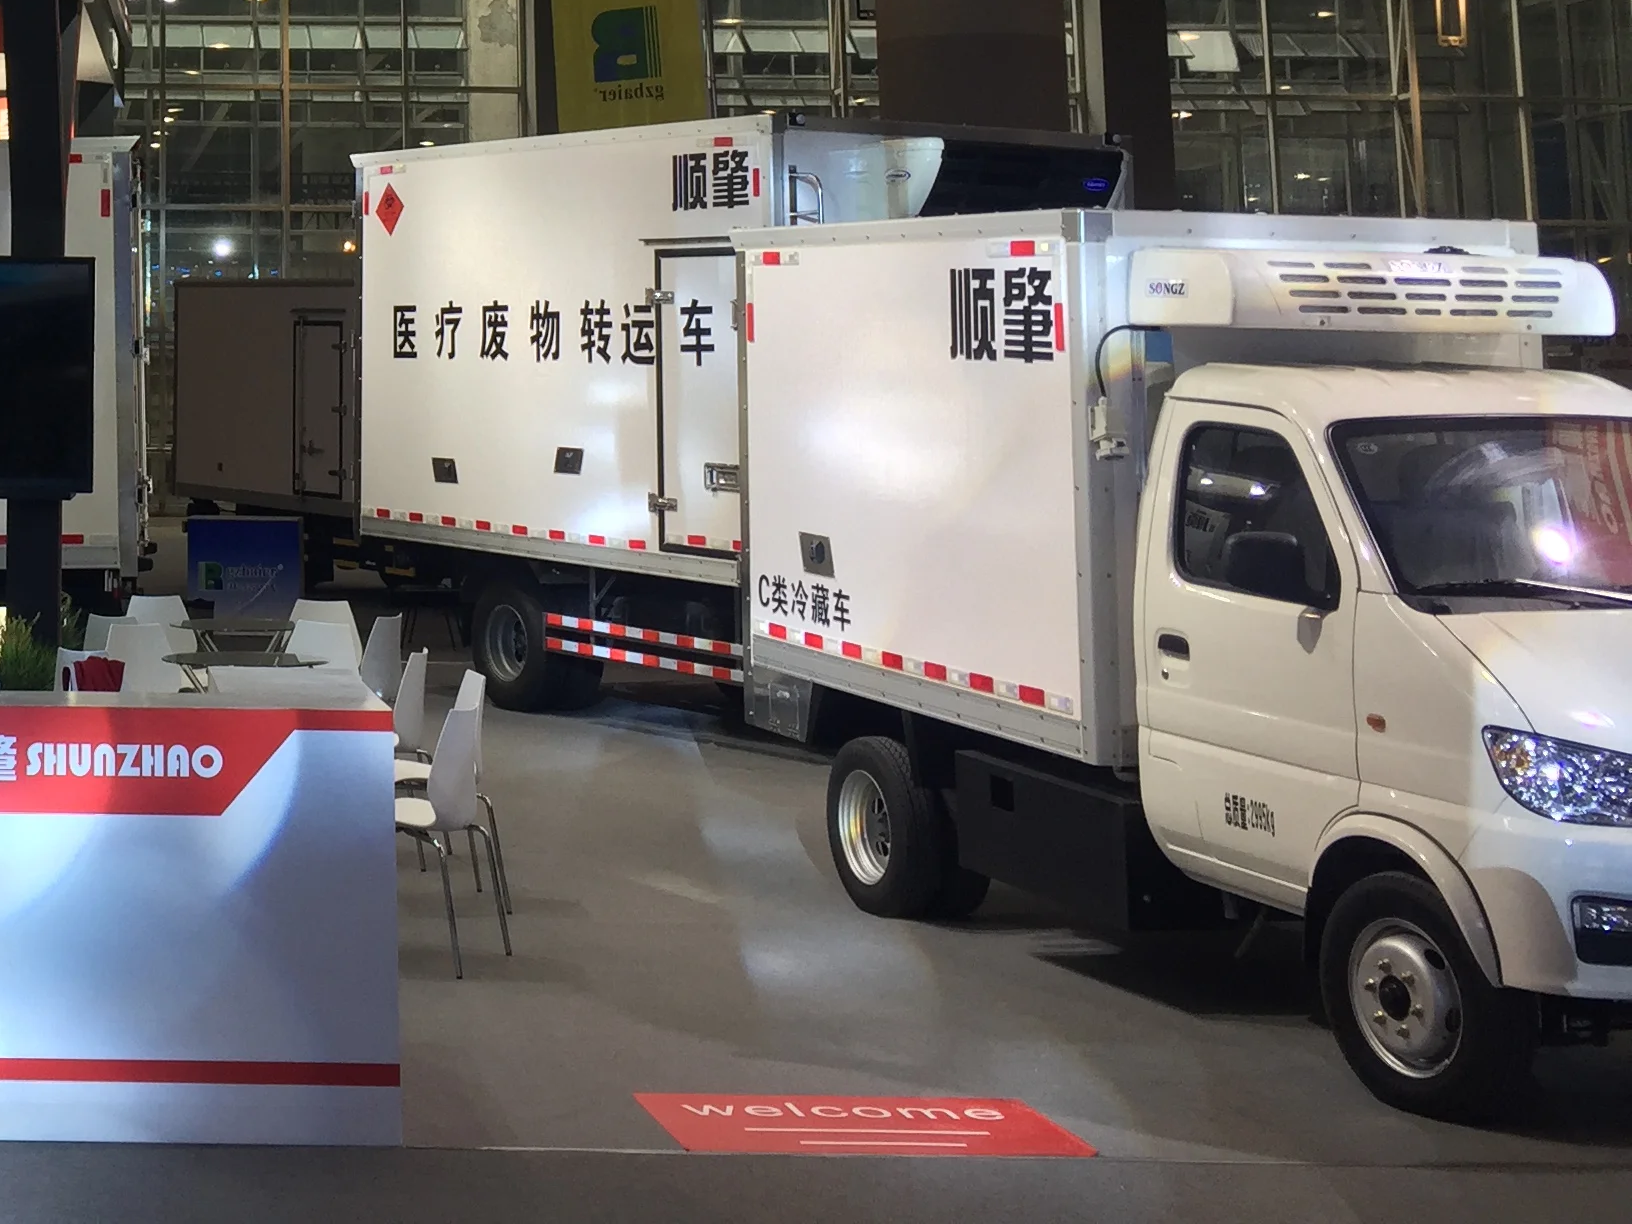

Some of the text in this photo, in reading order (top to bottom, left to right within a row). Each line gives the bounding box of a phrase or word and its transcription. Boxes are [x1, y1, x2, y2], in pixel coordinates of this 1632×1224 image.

[671, 150, 750, 212] 顺肇
[949, 266, 1054, 364] 顺肇
[1148, 282, 1186, 296] SONGZ
[392, 298, 716, 367] 医疗废物转运车
[758, 574, 852, 632] C类冷藏车
[26, 742, 223, 779] SHUNZHAO
[681, 1101, 1005, 1121] welcome
